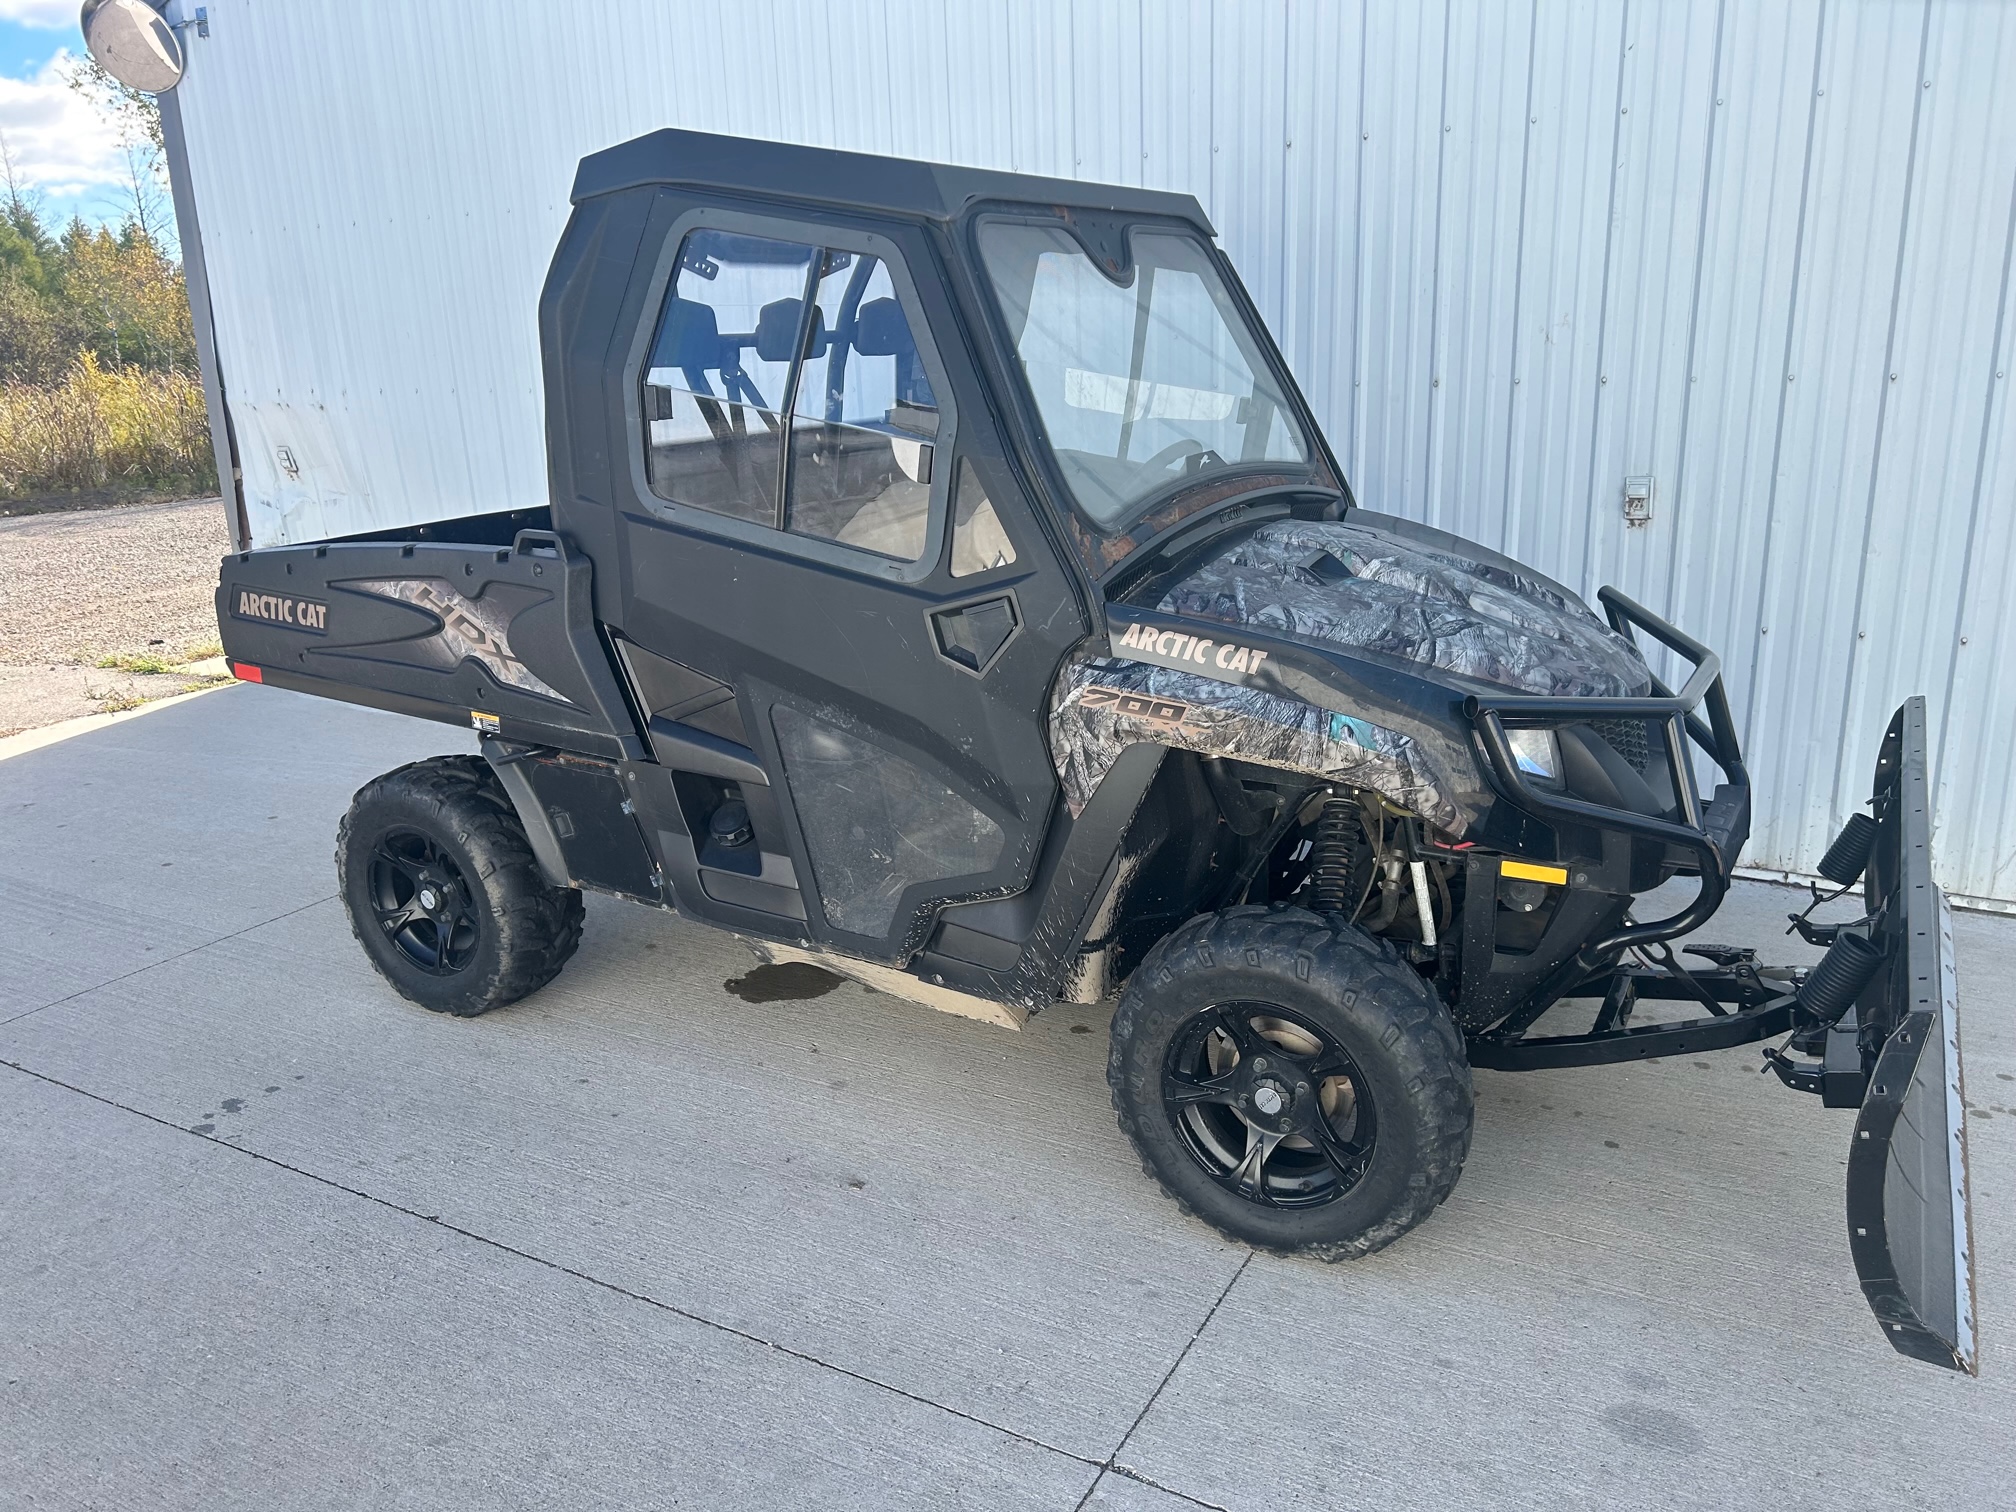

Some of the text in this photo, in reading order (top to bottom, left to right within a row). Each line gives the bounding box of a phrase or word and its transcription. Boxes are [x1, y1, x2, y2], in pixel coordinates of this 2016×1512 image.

[239, 591, 326, 629] ARCTIC CAT
[1119, 623, 1268, 676] ARCTIC CAT
[1080, 686, 1191, 723] 700
